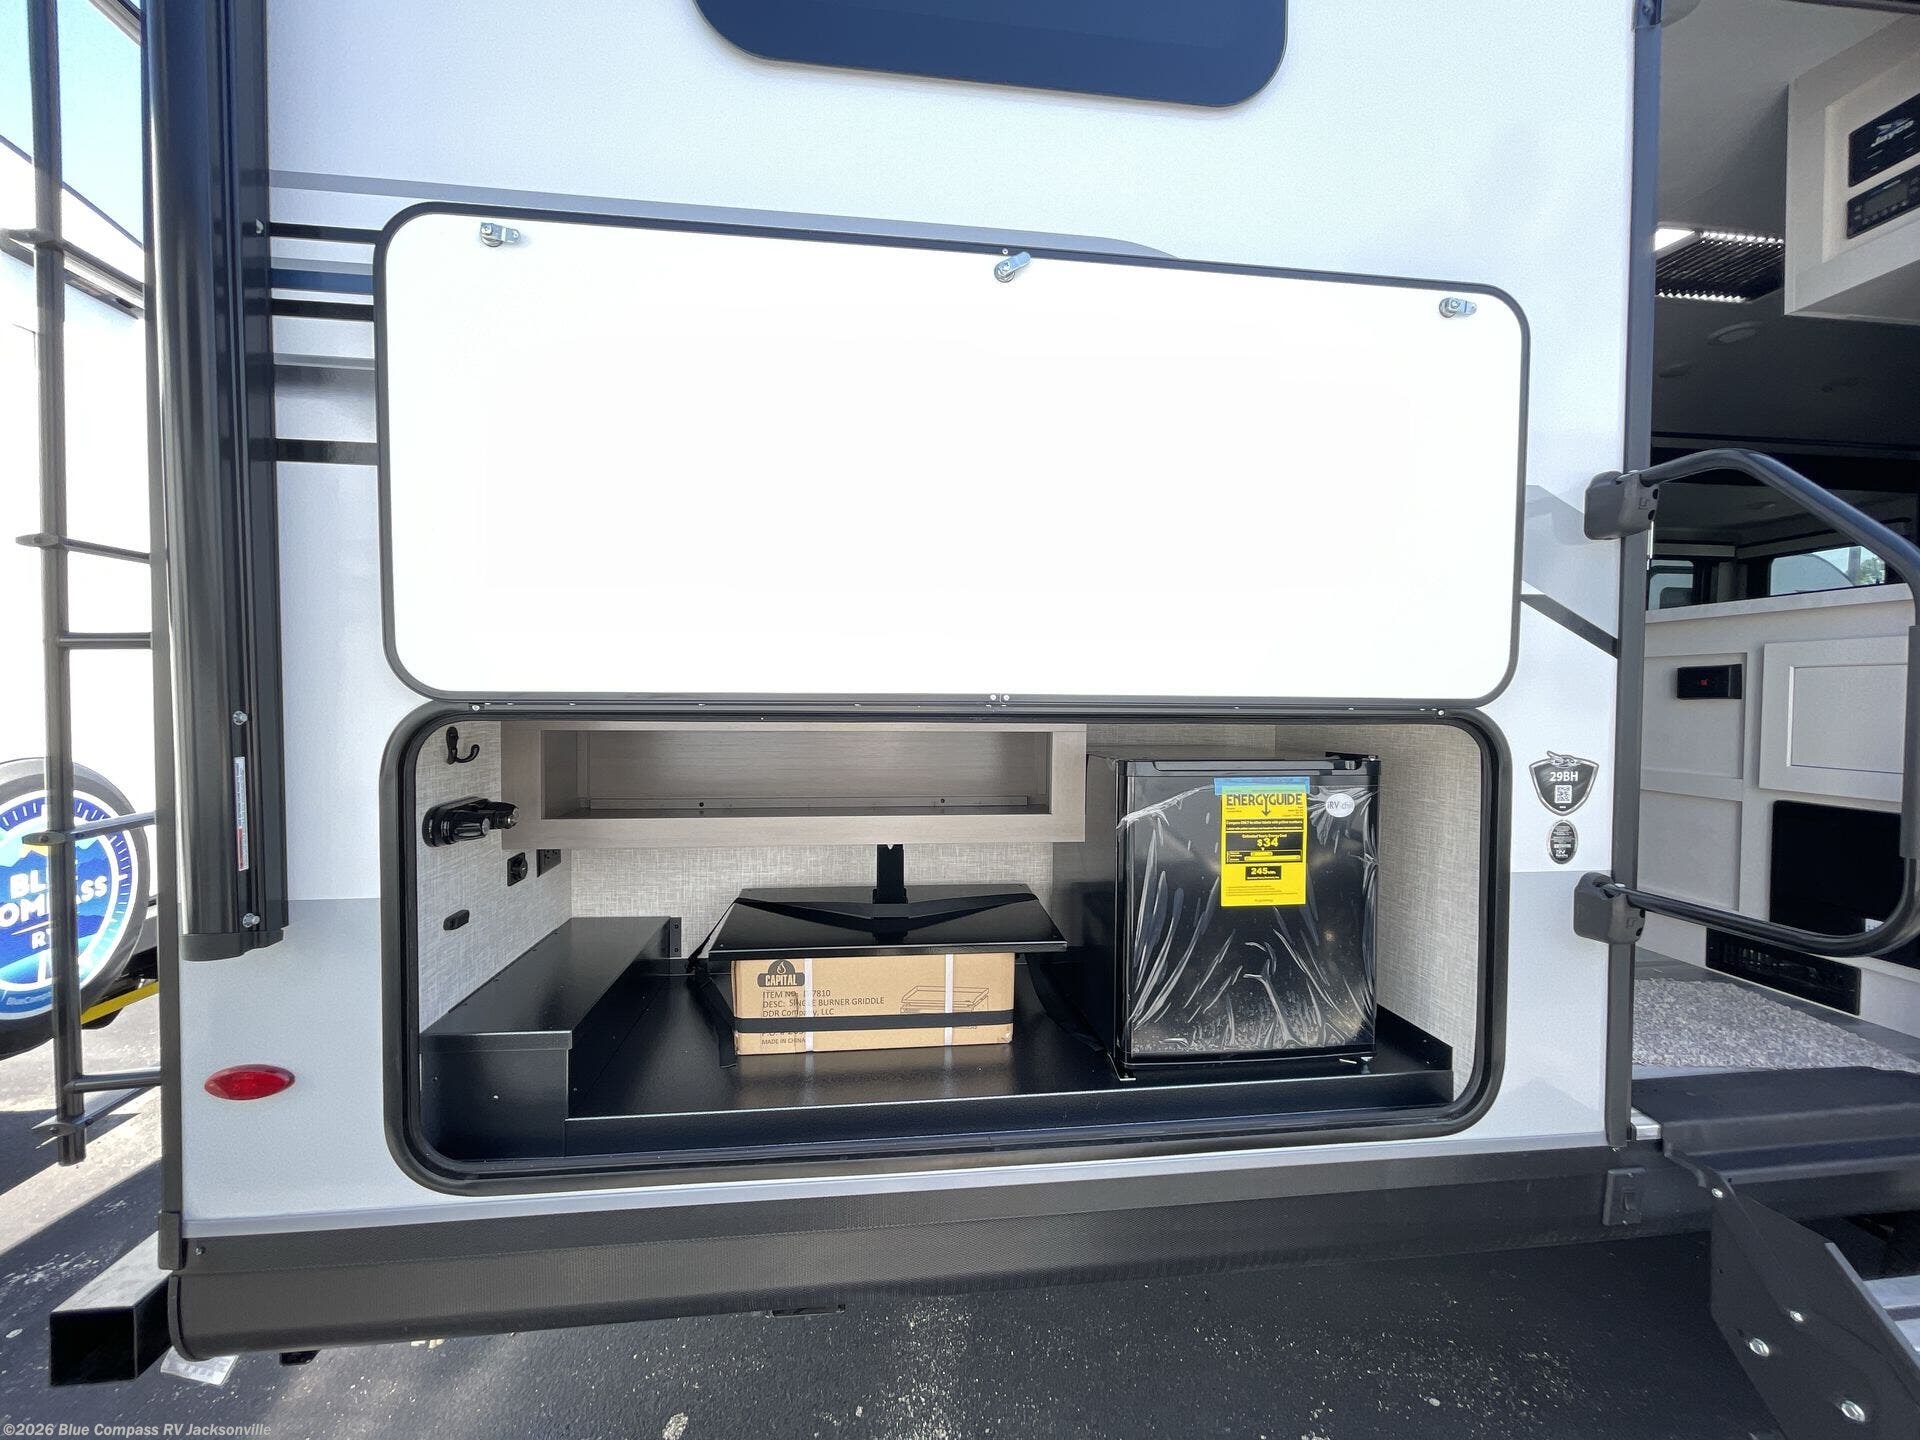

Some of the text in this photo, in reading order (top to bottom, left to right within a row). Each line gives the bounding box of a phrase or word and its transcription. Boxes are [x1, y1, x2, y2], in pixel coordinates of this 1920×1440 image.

[1550, 771, 1579, 782] 29BH
[1226, 793, 1303, 806] ENERGYGUIDE
[1256, 837, 1279, 847] $34
[0, 875, 108, 928] OMSS
[765, 974, 798, 986] CAPITAL
[763, 990, 783, 999] ITEM
[789, 999, 816, 1007] SINGE
[818, 998, 851, 1006] BURNER
[851, 996, 885, 1005] GRIDDLE
[762, 1008, 835, 1018] DDR Compay, LLC
